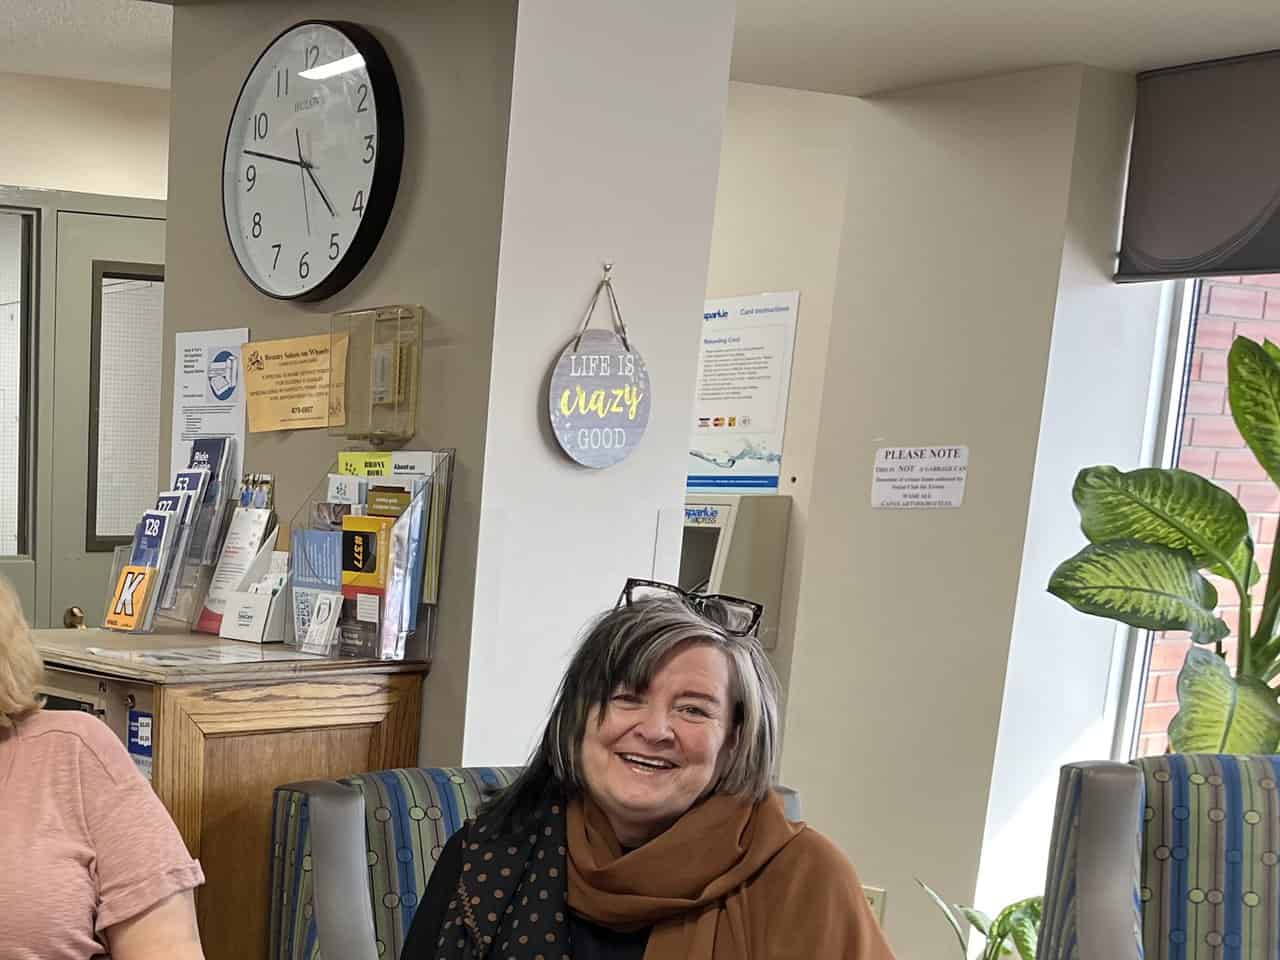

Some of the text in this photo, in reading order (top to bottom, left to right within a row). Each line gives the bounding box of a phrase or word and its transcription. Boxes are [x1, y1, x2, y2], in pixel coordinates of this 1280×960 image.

[276, 68, 289, 98] 11
[356, 84, 368, 113] 2
[254, 112, 268, 141] 10
[362, 134, 375, 164] 3
[246, 165, 257, 193] 9
[351, 190, 364, 218] 4
[251, 212, 262, 239] 8
[271, 244, 282, 270] 7
[328, 233, 340, 260] 5
[298, 251, 310, 279] 6
[570, 354, 635, 377] LIFE IS
[560, 383, 644, 421] crazy
[577, 427, 626, 450] GOOD
[194, 450, 209, 461] Ride
[393, 463, 409, 471] About
[884, 447, 961, 461] PLEASE NOTE
[144, 518, 161, 537] 128
[113, 571, 146, 617] K
